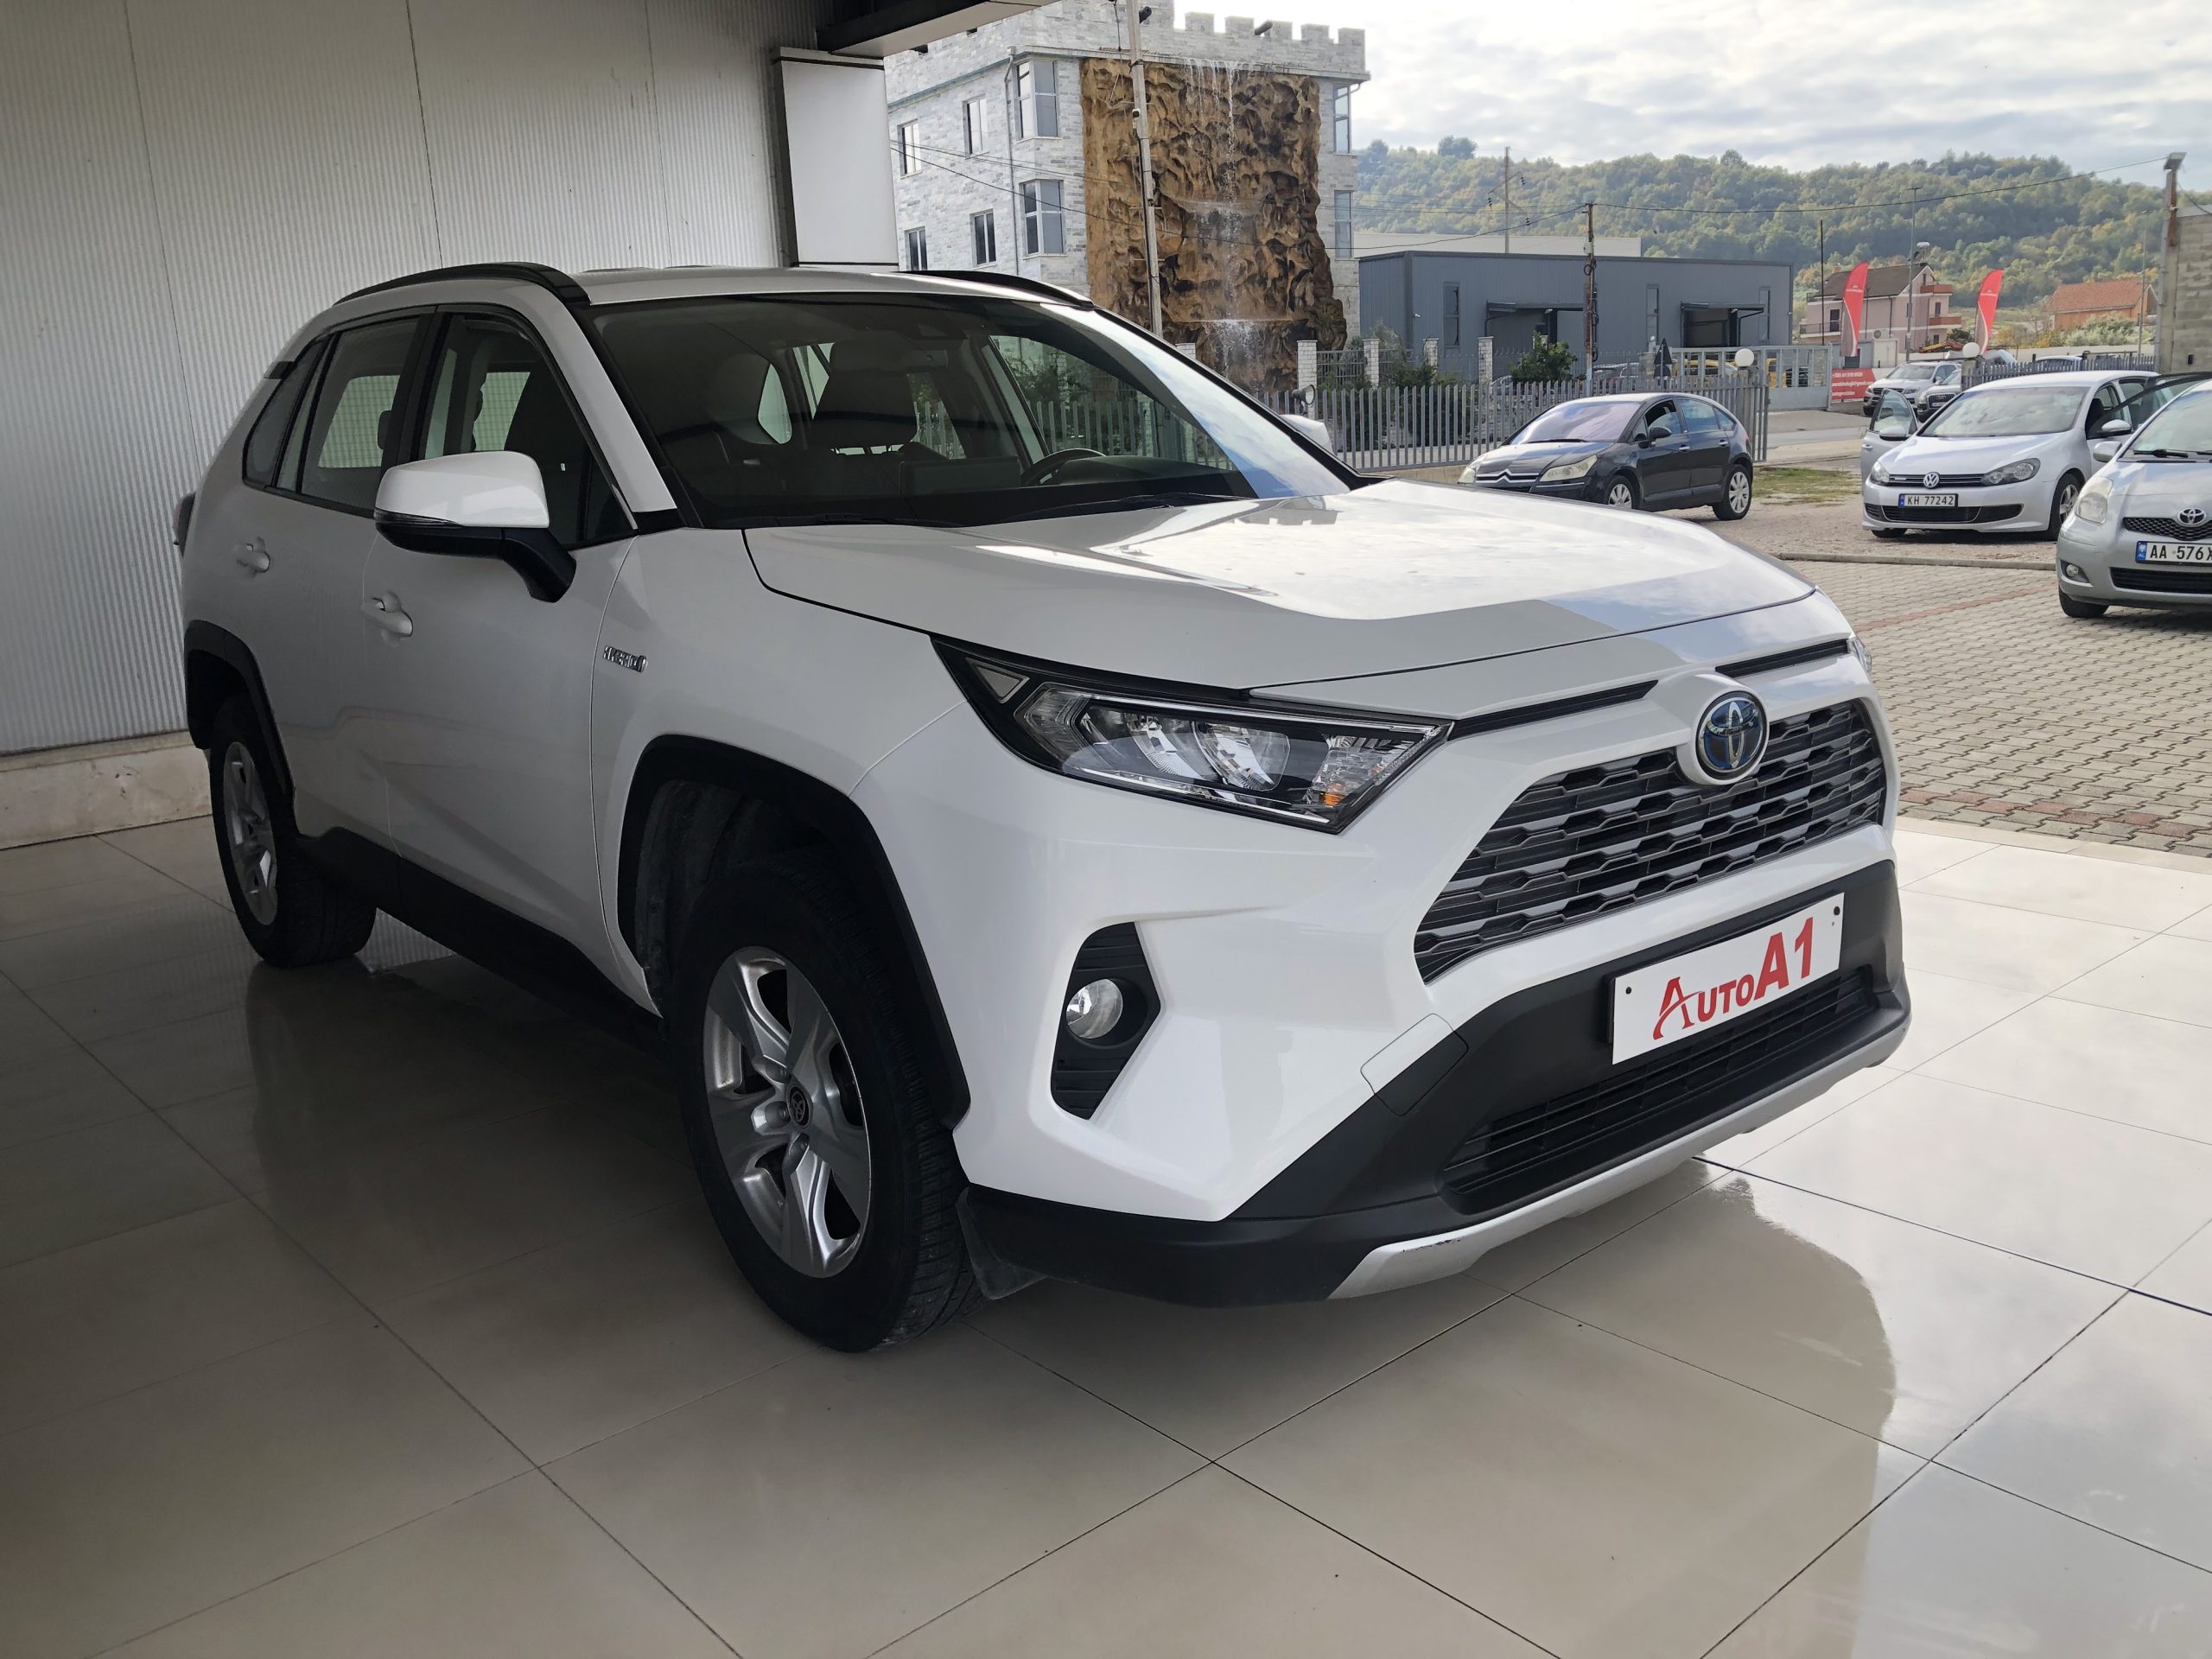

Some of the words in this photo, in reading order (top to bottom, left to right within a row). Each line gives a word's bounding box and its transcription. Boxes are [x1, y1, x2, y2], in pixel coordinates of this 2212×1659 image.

[1907, 496, 1920, 505] KH
[1924, 496, 1954, 505] 77242
[2150, 544, 2167, 559] AA
